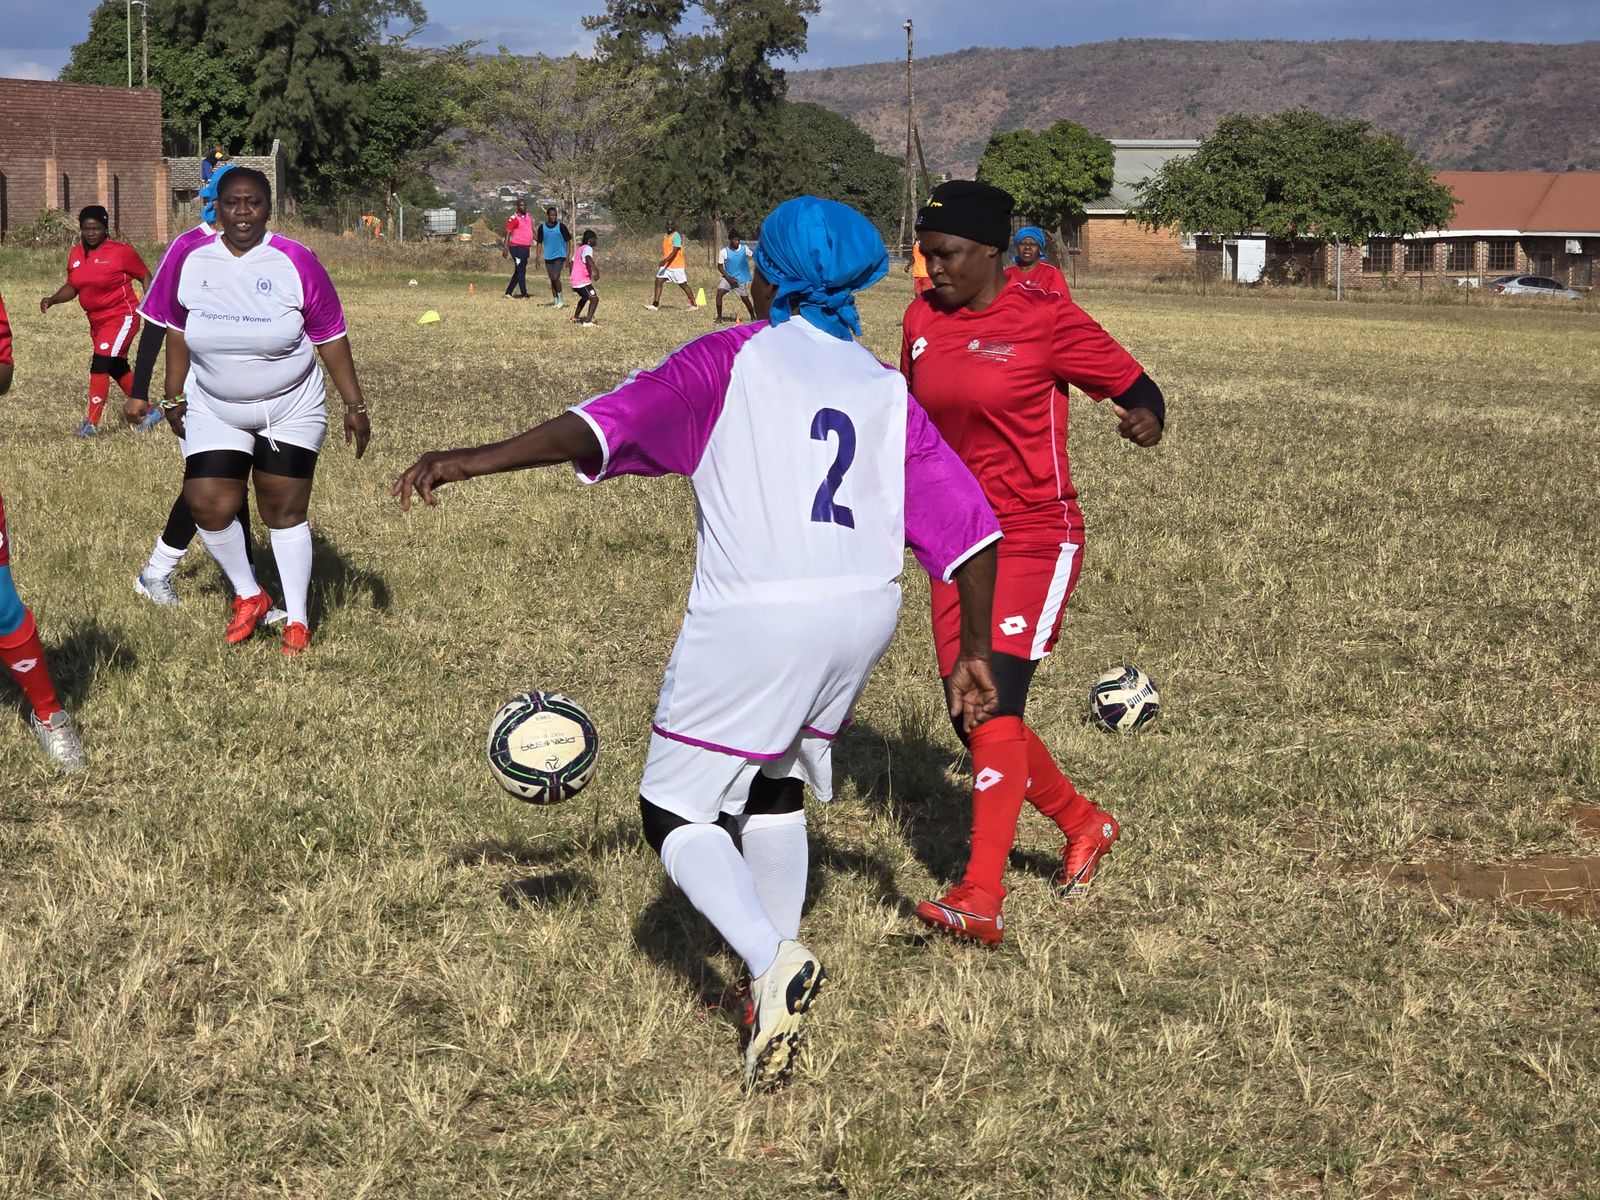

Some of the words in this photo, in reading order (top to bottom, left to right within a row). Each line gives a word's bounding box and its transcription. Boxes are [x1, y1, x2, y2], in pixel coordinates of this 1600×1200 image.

[200, 311, 240, 323] Supporting
[242, 315, 272, 323] Women
[810, 407, 857, 530] 2
[520, 736, 576, 752] PRIMERA
